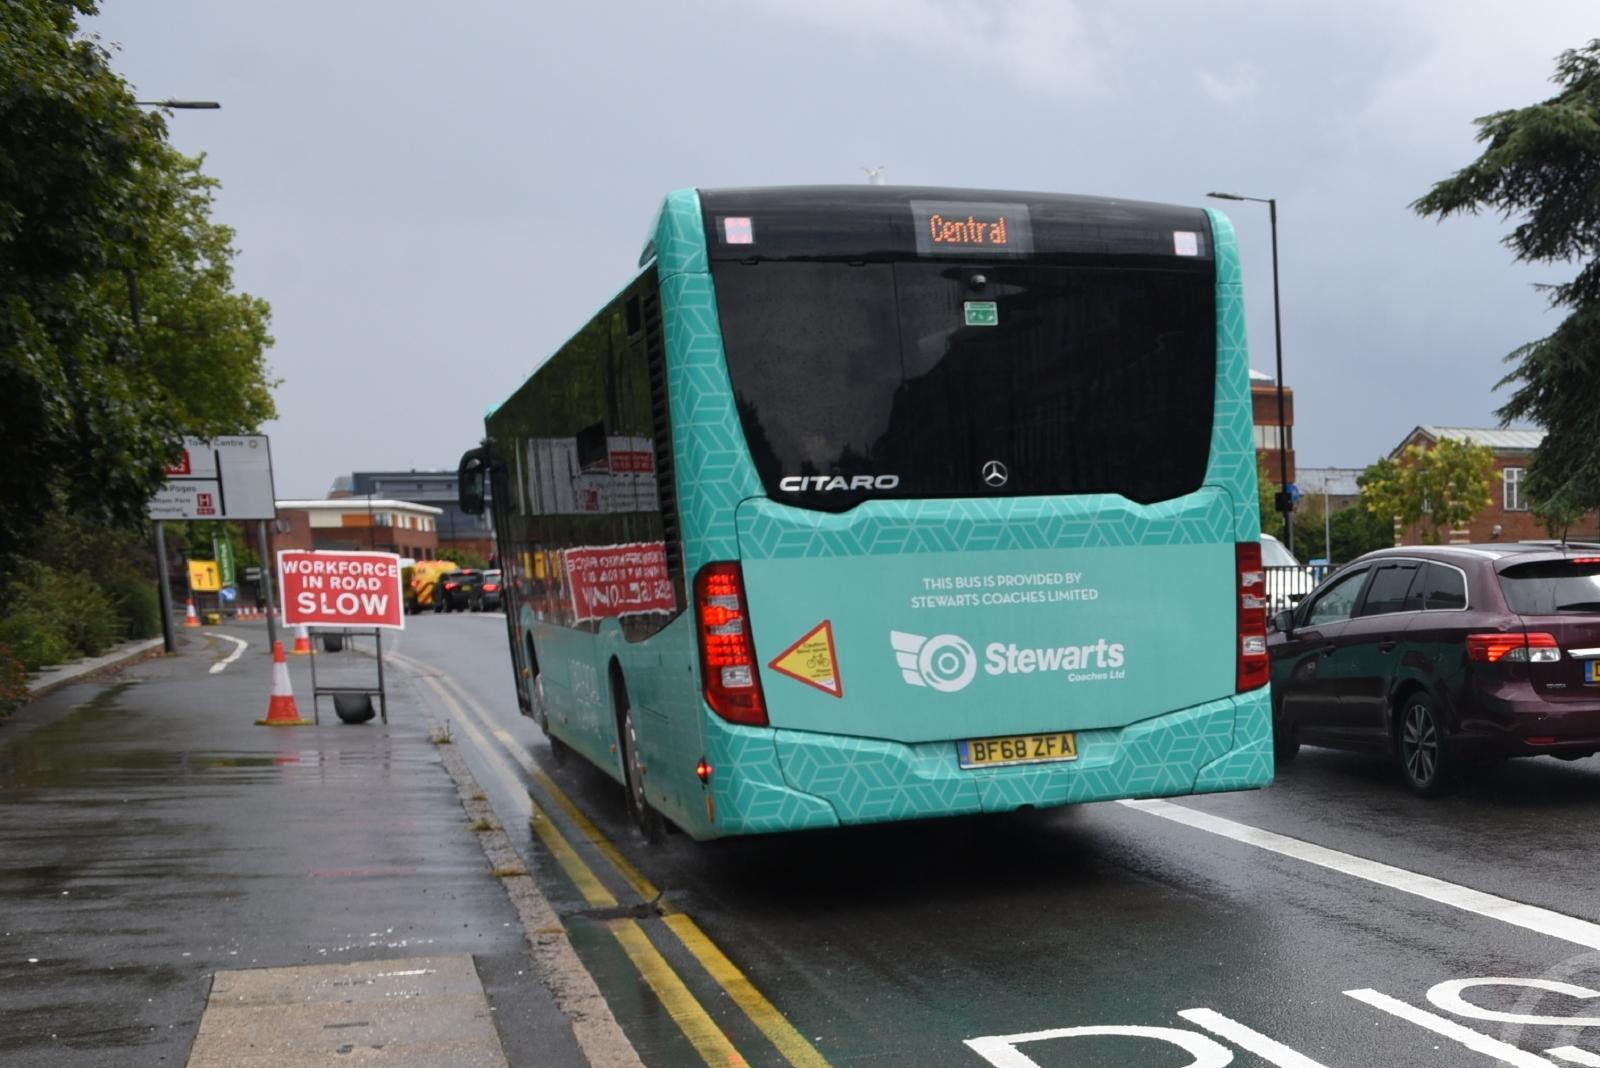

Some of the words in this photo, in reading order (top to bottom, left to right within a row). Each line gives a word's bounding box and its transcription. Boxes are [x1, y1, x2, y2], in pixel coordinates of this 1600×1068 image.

[930, 214, 1007, 243] Central
[213, 439, 244, 447] Centre
[780, 475, 899, 491] CITARO
[283, 560, 397, 578] WORKFORCE
[302, 576, 323, 589] IN
[330, 576, 382, 591] ROAD
[922, 578, 953, 590] THIS
[955, 576, 982, 589] BUS
[984, 576, 995, 587] IS
[998, 573, 1063, 587] PROVIDED
[1066, 572, 1082, 584] BY
[297, 591, 389, 616] SLOW
[911, 594, 980, 609] STEWARTS
[982, 591, 1045, 605] COACHES
[1048, 588, 1098, 602] LIMITED
[984, 638, 1125, 675] Stewarts
[1068, 672, 1107, 682] Coaches
[1110, 670, 1125, 679] Ltd
[973, 740, 1027, 761] BF68
[1032, 735, 1072, 757] ZFA
